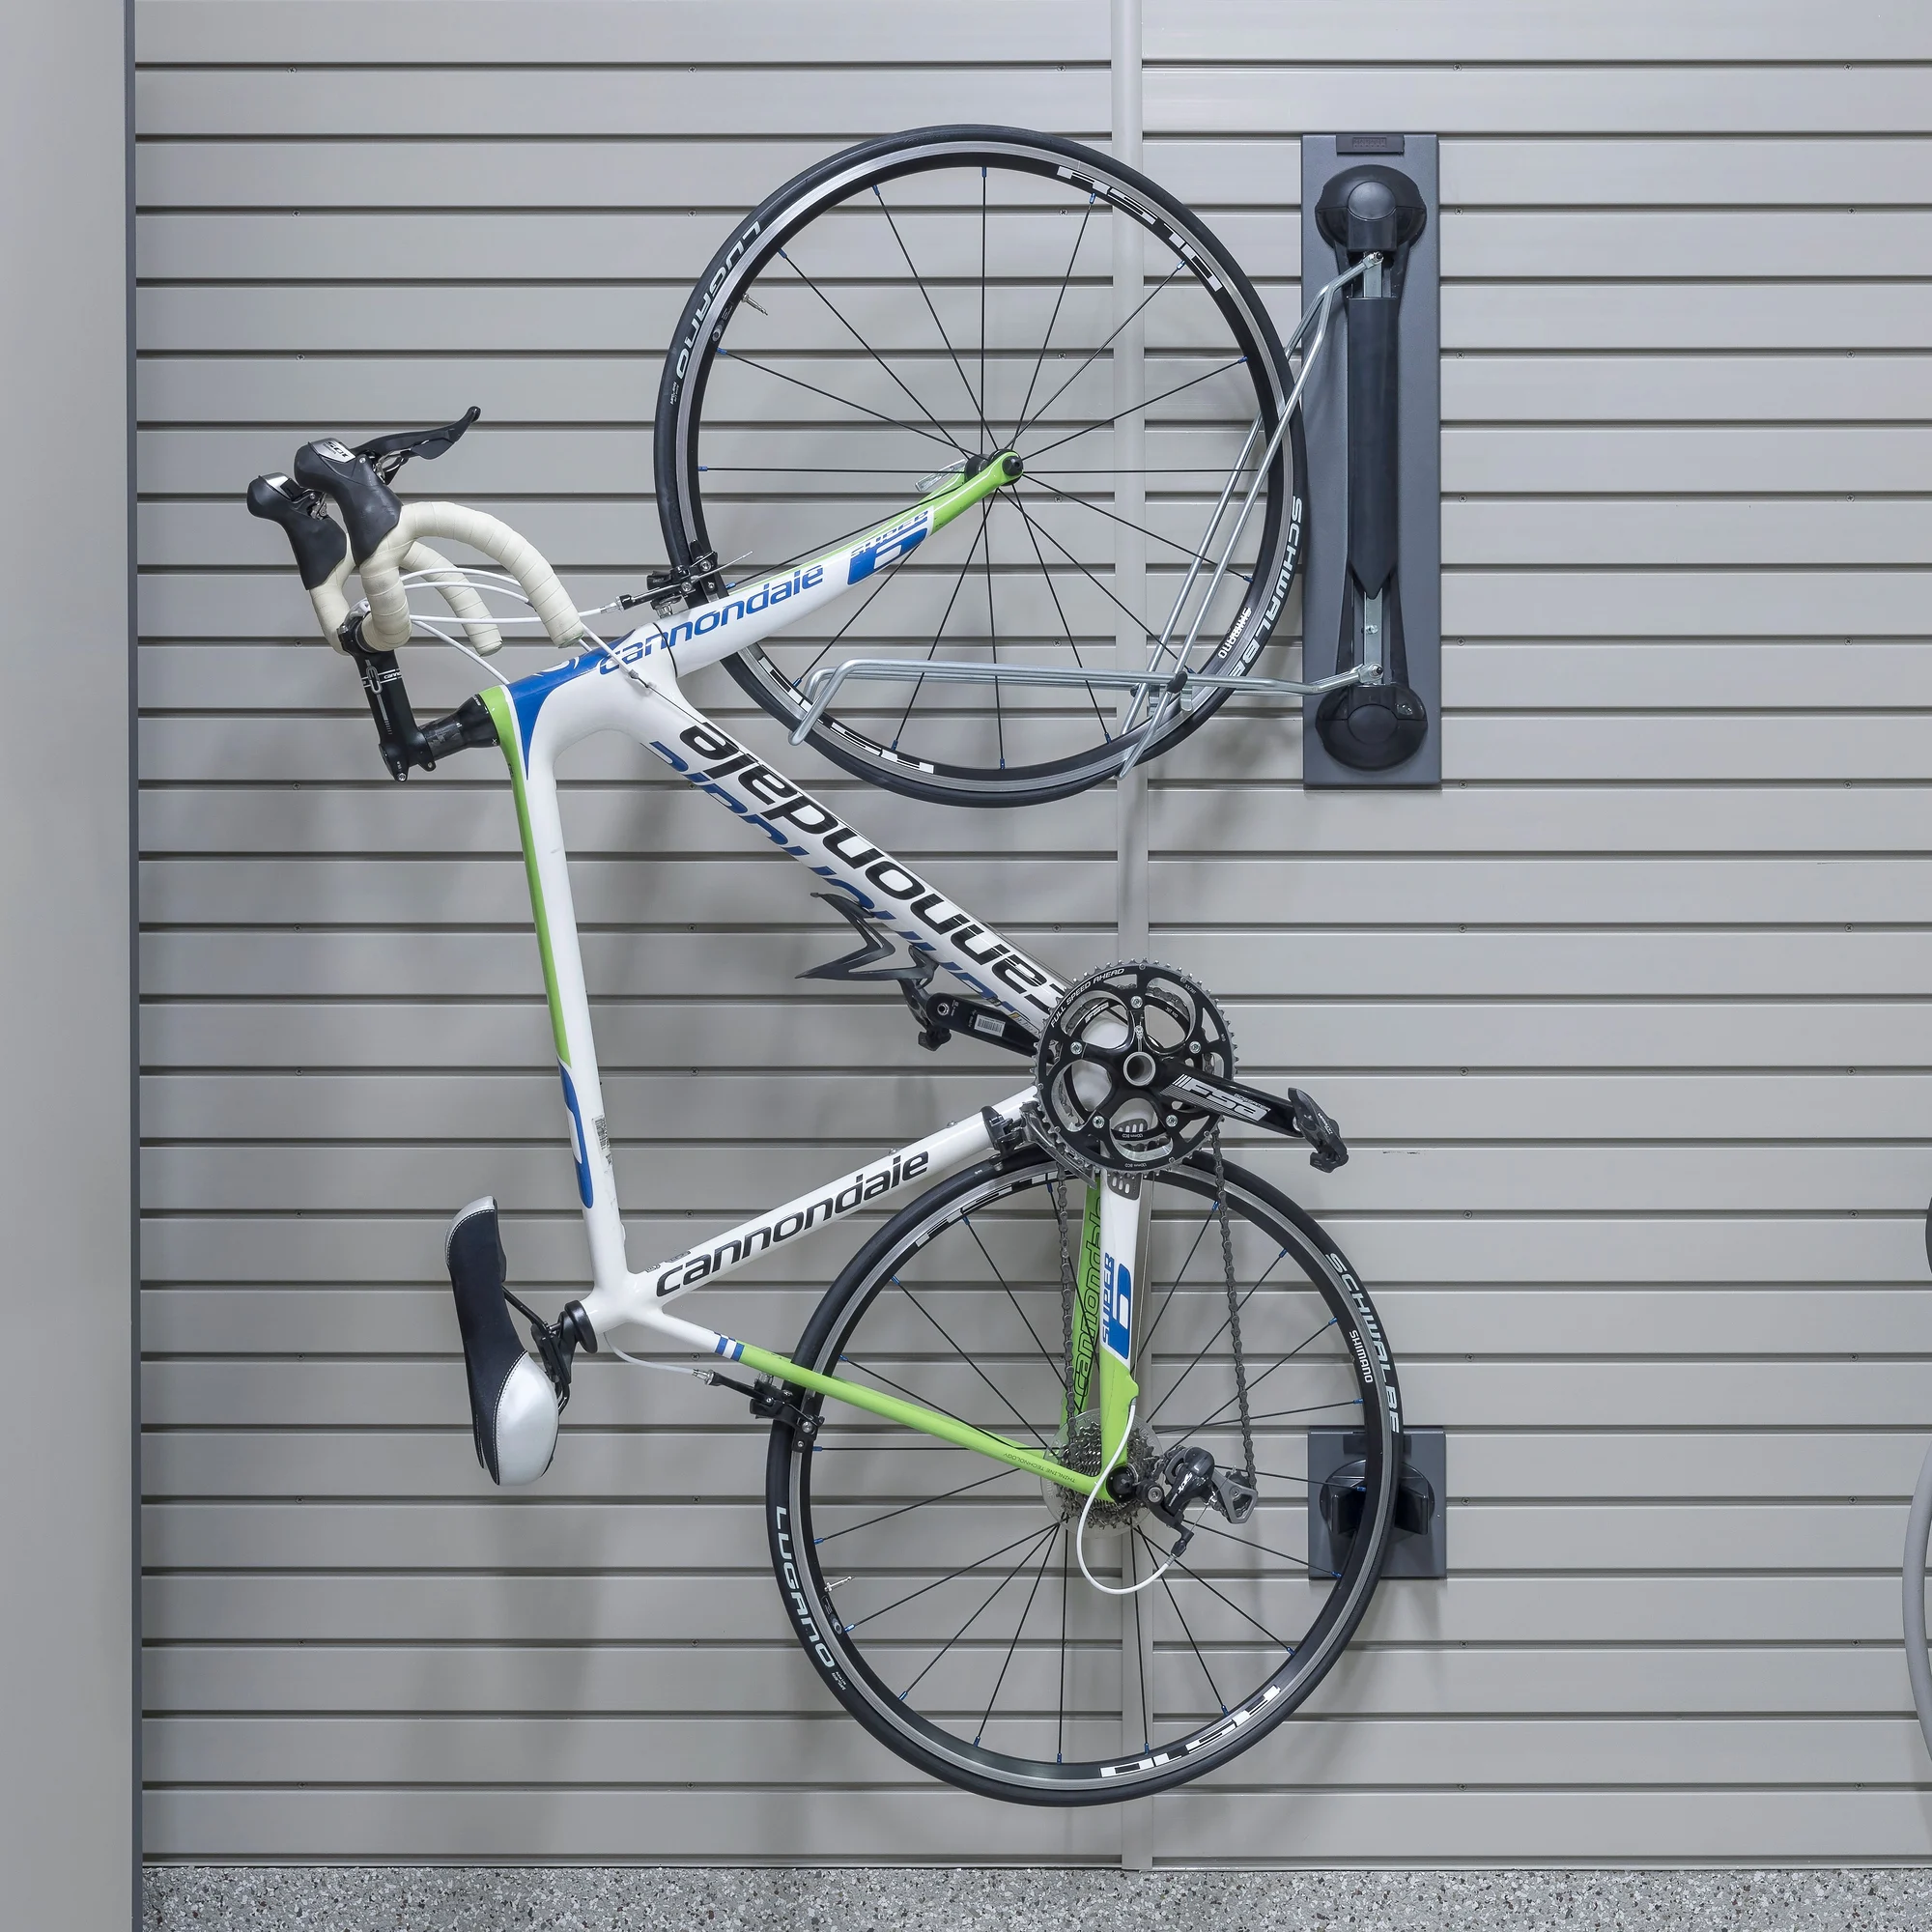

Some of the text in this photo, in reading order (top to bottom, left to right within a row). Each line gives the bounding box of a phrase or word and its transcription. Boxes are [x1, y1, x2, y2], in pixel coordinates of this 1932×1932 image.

[676, 221, 761, 379] LUGANO
[599, 565, 823, 675] cannondale
[1218, 608, 1252, 659] SHIMANO
[1228, 496, 1302, 676] SCHWALBE
[1050, 1006, 1066, 1028] FULL
[1065, 980, 1092, 1006] SPEED
[1093, 968, 1124, 984] AHEAD
[656, 1151, 929, 1297] cannondale
[1102, 1252, 1115, 1344] SUPER
[1325, 1252, 1400, 1434] SCHWALBE
[1349, 1329, 1374, 1383] SHIMANO
[1004, 1453, 1076, 1484] THINLINE TECHNOLOGY
[776, 1505, 836, 1668] LUGANO
